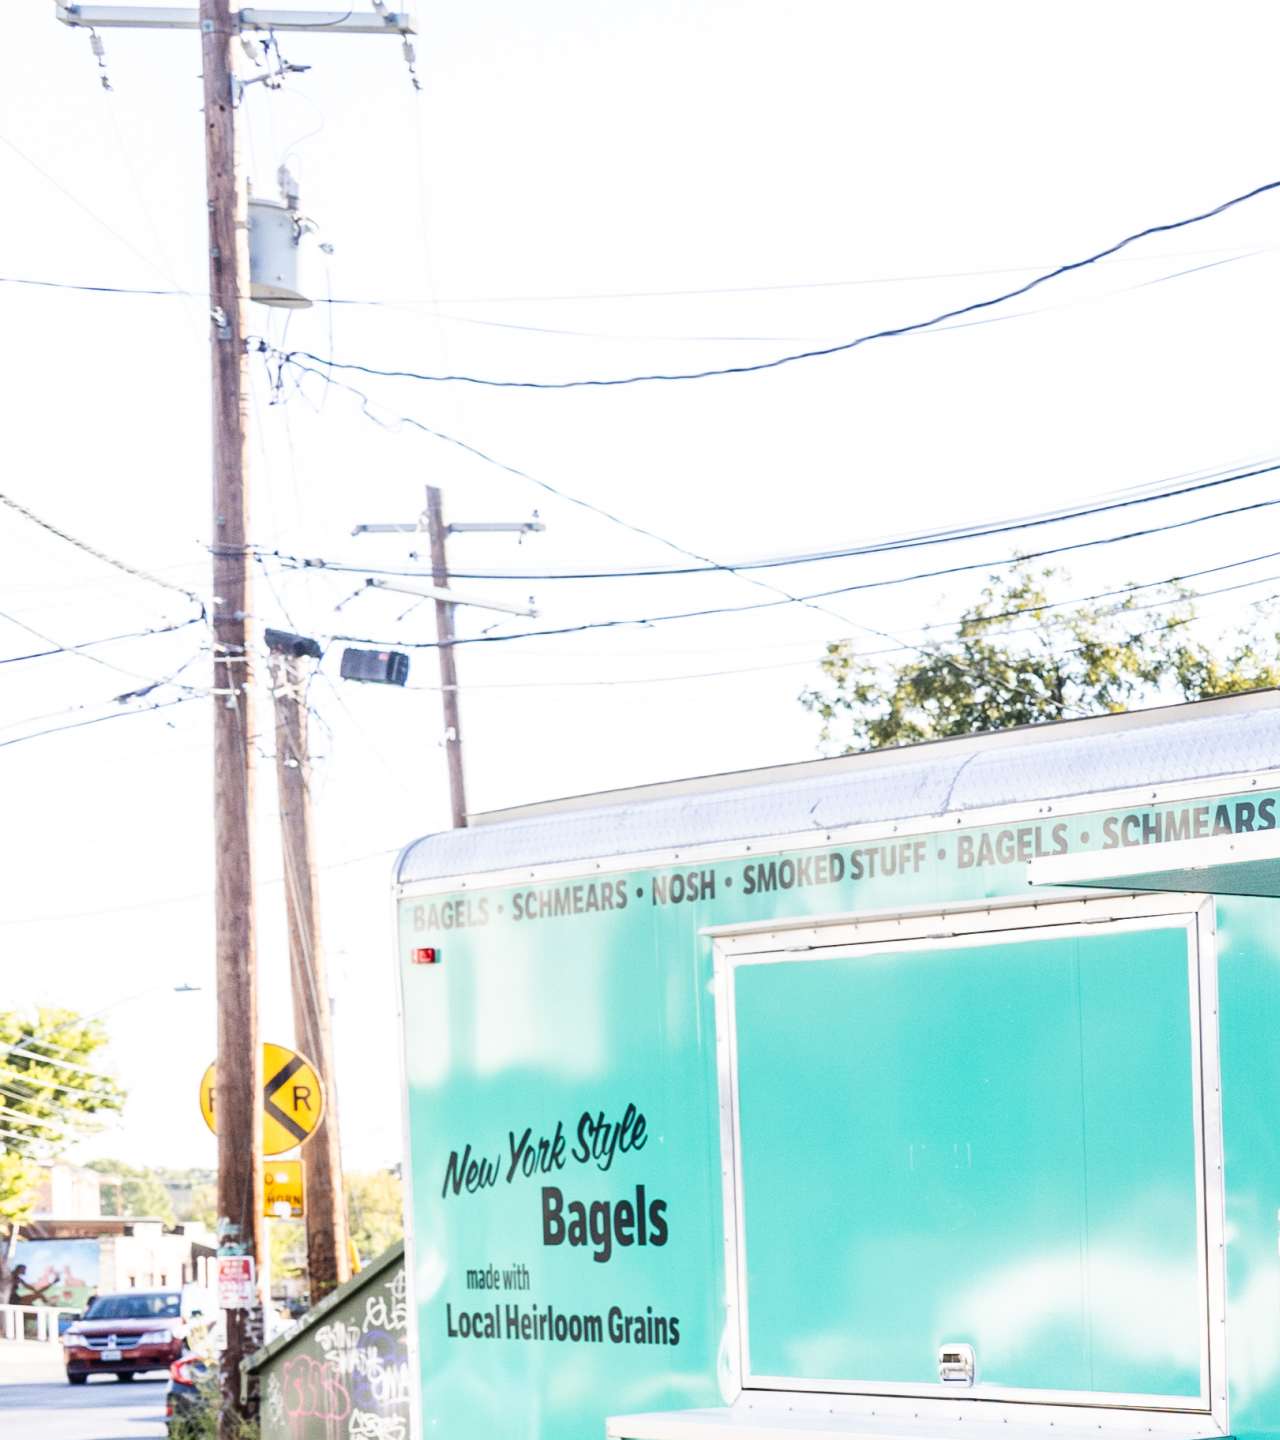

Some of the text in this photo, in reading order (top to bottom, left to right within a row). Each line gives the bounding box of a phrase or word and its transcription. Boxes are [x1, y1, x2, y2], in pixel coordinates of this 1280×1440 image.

[412, 896, 490, 932] BAGELS
[511, 880, 628, 921] SCHMEARS
[651, 869, 716, 906] NOSH
[742, 851, 846, 895] SMOKED
[849, 841, 928, 880] STUFF
[957, 822, 1069, 869] BAGELS
[1101, 798, 1276, 850] SCHMEARS
[293, 1085, 312, 1111] R
[442, 1103, 649, 1198] New York Style
[541, 1184, 669, 1263] Bagels
[466, 1263, 530, 1290] made with
[446, 1302, 681, 1346] Local Heirloom Grains
